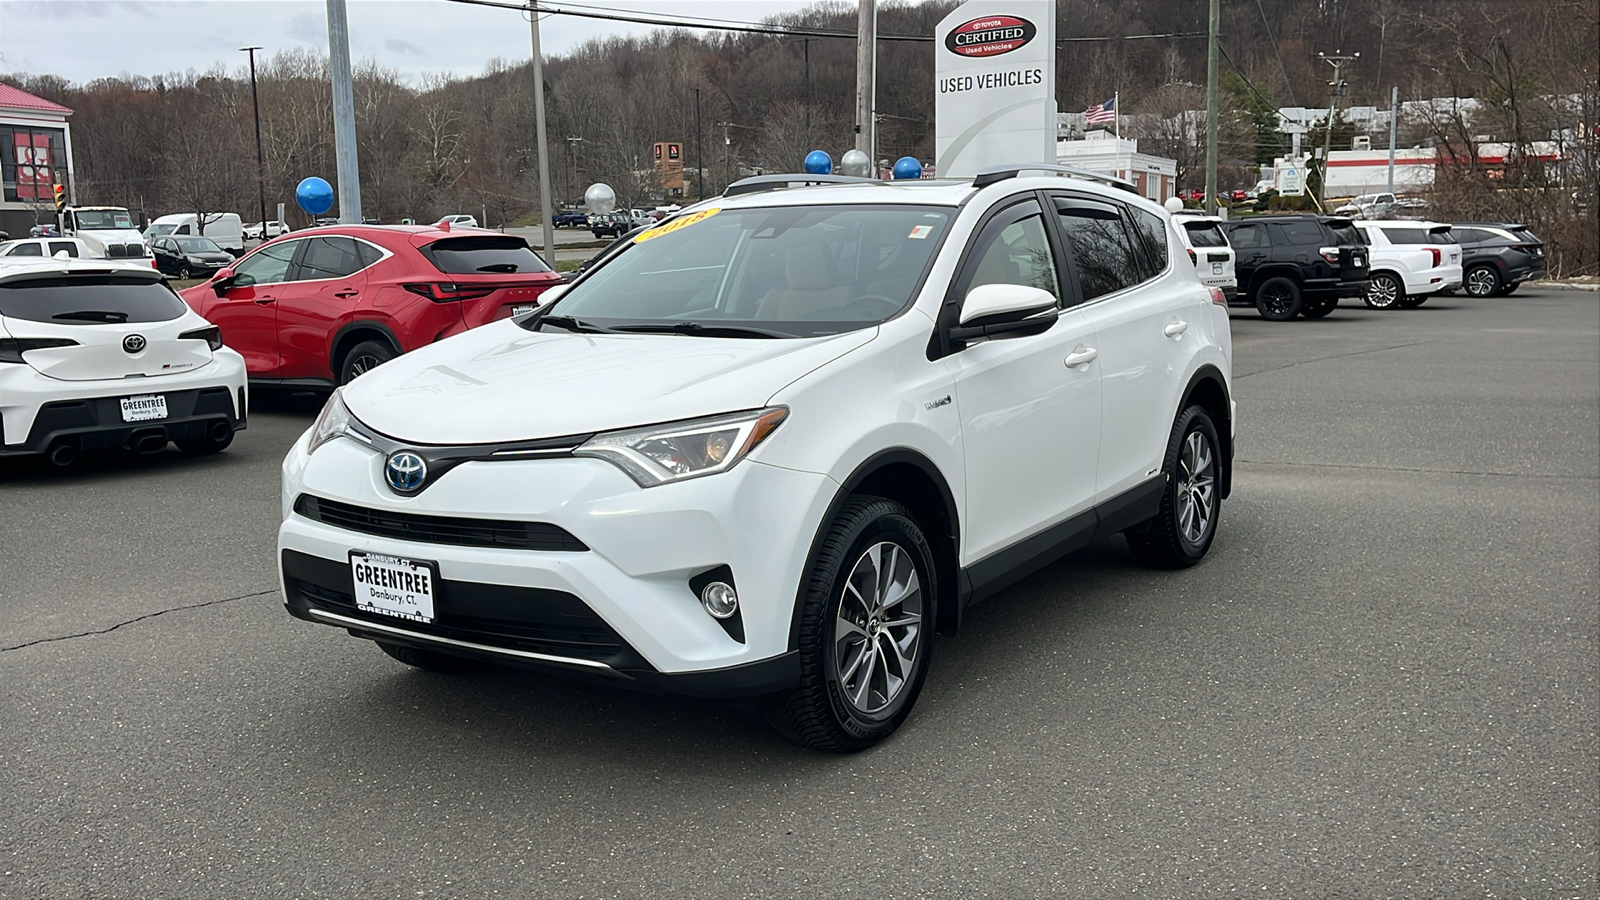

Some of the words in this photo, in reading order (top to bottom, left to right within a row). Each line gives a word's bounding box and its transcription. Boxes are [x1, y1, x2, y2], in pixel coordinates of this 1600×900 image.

[981, 20, 1002, 28] TOYOTA
[955, 28, 1024, 45] CERTIFIED
[965, 46, 983, 54] Used
[983, 43, 1013, 52] Vehicles
[940, 76, 973, 94] USED
[976, 69, 1042, 89] VEHICLES
[646, 210, 708, 239] 2018
[122, 398, 165, 410] GREENTREE
[355, 563, 429, 595] GREENTREE
[370, 587, 404, 605] Danbury,
[406, 594, 417, 605] CT.
[357, 604, 431, 624] GREENTREE
